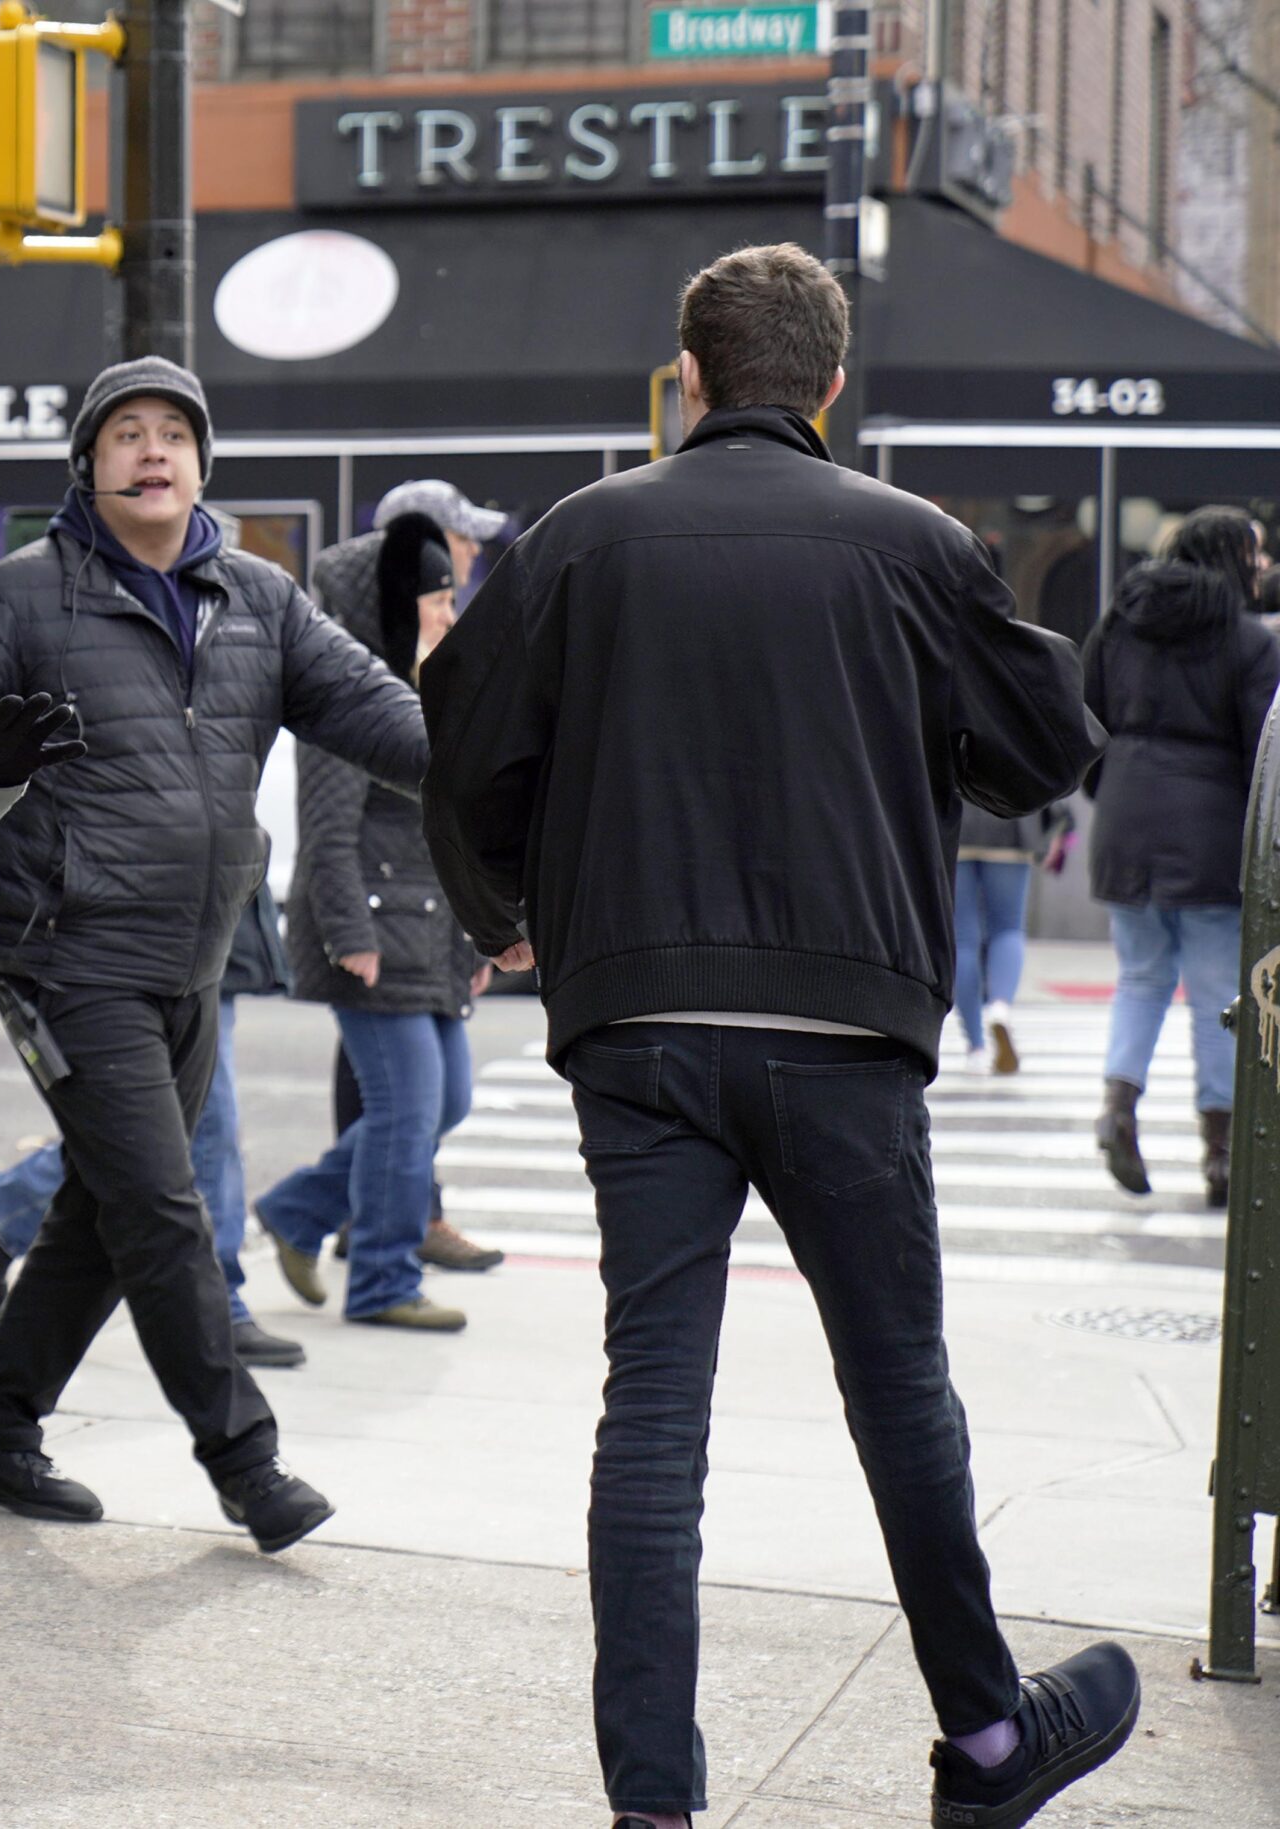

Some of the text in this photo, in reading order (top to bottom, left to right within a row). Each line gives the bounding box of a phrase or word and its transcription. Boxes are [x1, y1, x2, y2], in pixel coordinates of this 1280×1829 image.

[668, 9, 803, 55] Broadway
[337, 96, 833, 188] TRESTLE
[1052, 377, 1166, 416] 34-02
